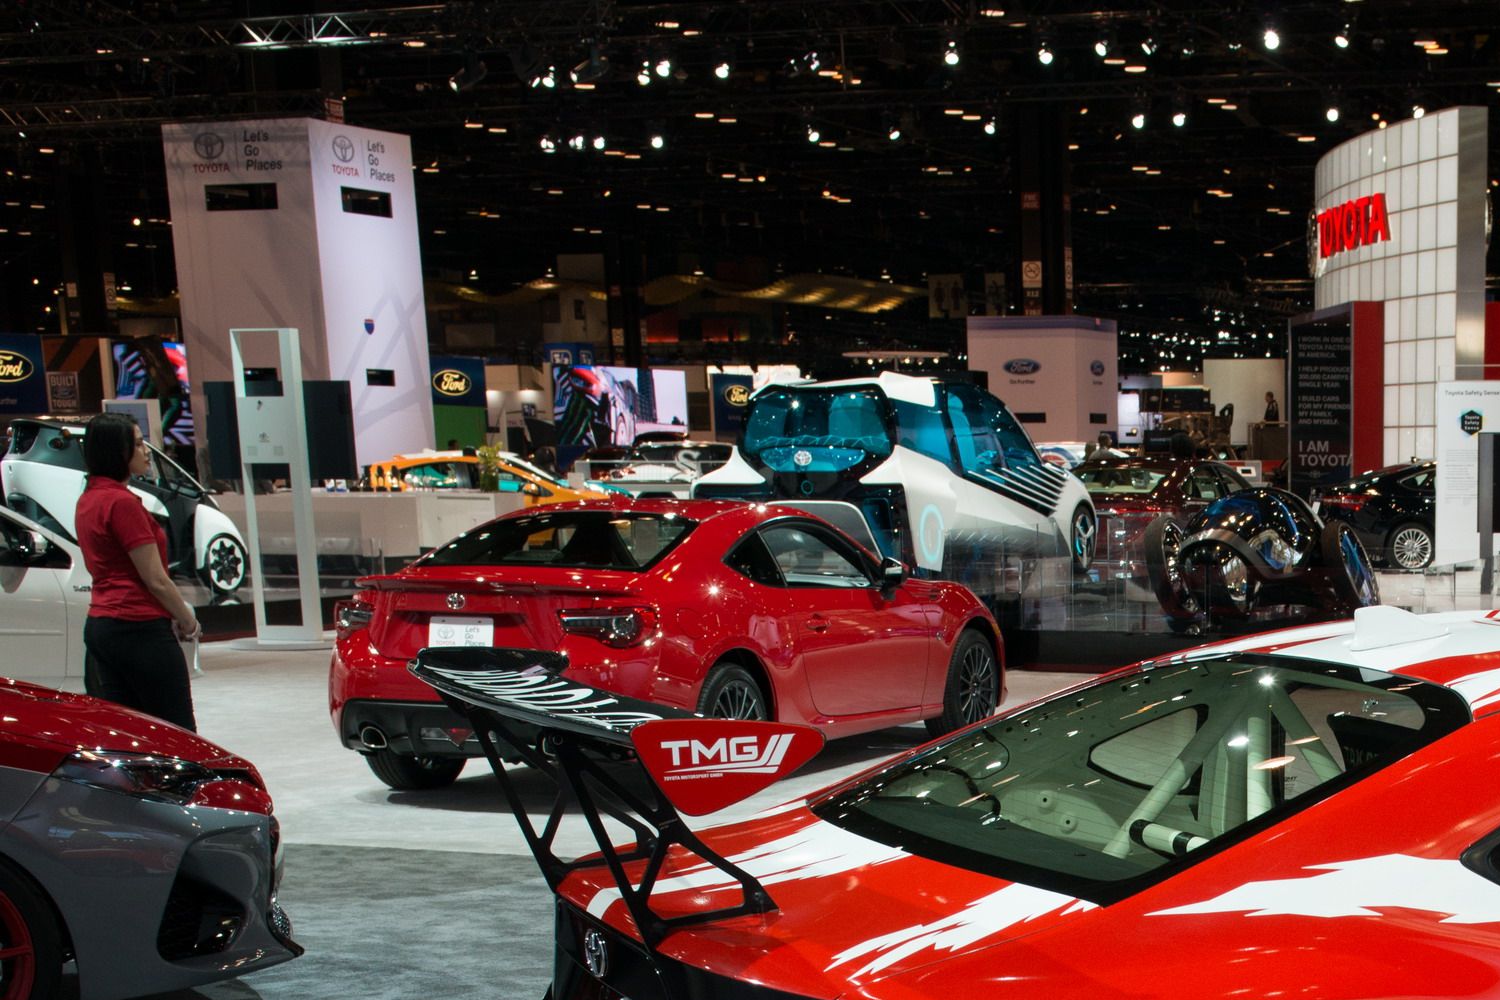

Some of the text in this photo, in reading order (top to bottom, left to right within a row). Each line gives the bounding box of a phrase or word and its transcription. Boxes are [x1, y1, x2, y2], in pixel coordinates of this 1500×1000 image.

[242, 129, 270, 143] Let's
[244, 145, 260, 157] Go
[366, 140, 386, 154] Let's
[245, 159, 283, 171] Places
[367, 154, 380, 167] Go
[193, 163, 230, 174] TOYOTA
[331, 164, 360, 177] TOYOTA
[369, 169, 396, 183] Places
[1316, 192, 1392, 259] TOYOTA
[50, 375, 75, 387] BUILT
[441, 373, 467, 392] Ford
[1306, 440, 1329, 453] AM
[464, 632, 474, 640] Go
[660, 735, 759, 766] TMG
